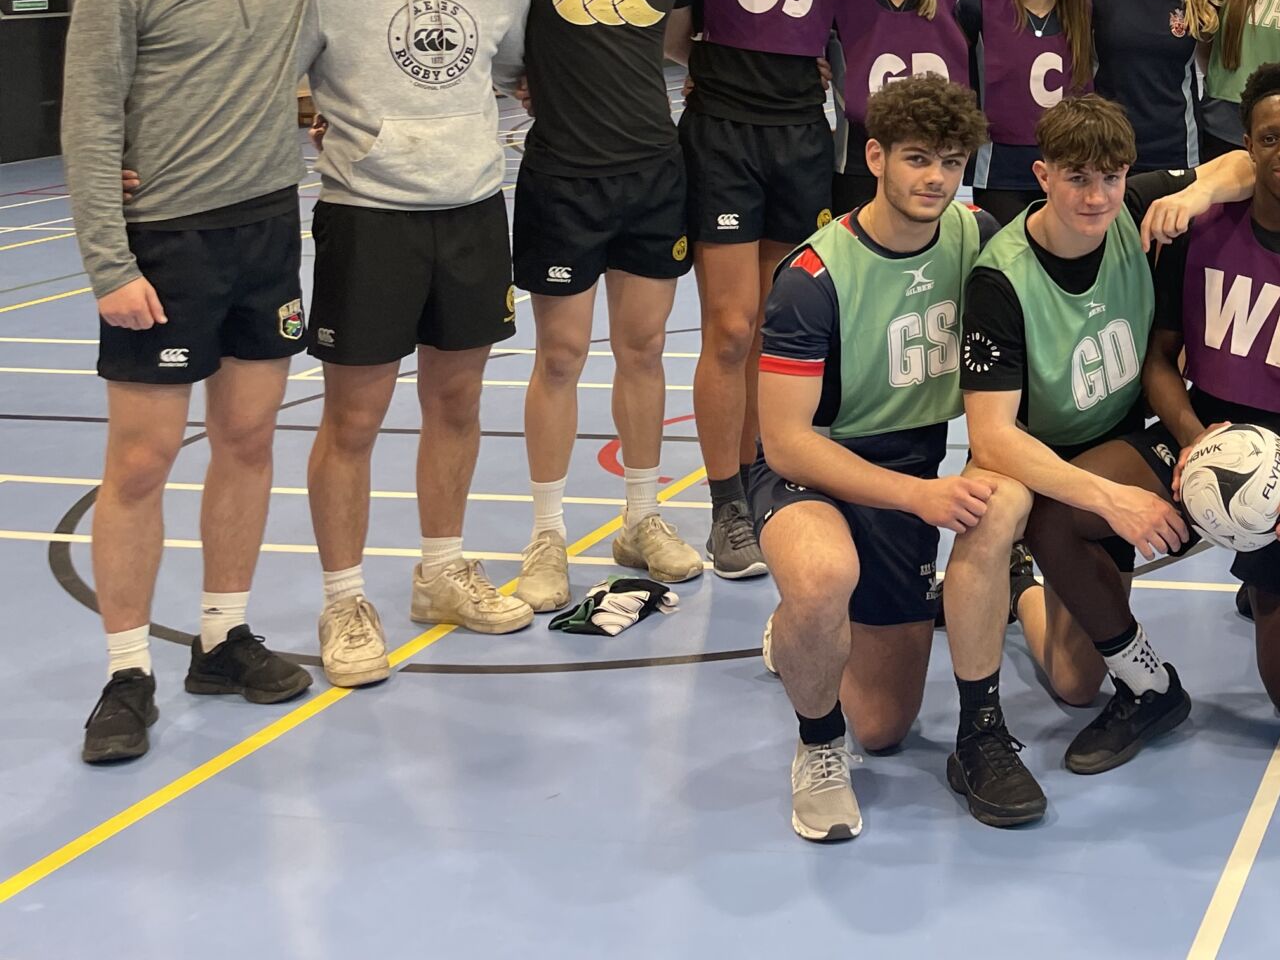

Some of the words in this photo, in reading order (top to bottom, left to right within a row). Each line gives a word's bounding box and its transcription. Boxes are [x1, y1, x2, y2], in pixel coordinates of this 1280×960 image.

[395, 48, 441, 81] RUGBY
[446, 46, 475, 78] CLUB
[1029, 51, 1064, 109] C
[887, 299, 961, 388] GS
[1071, 318, 1140, 412] GD
